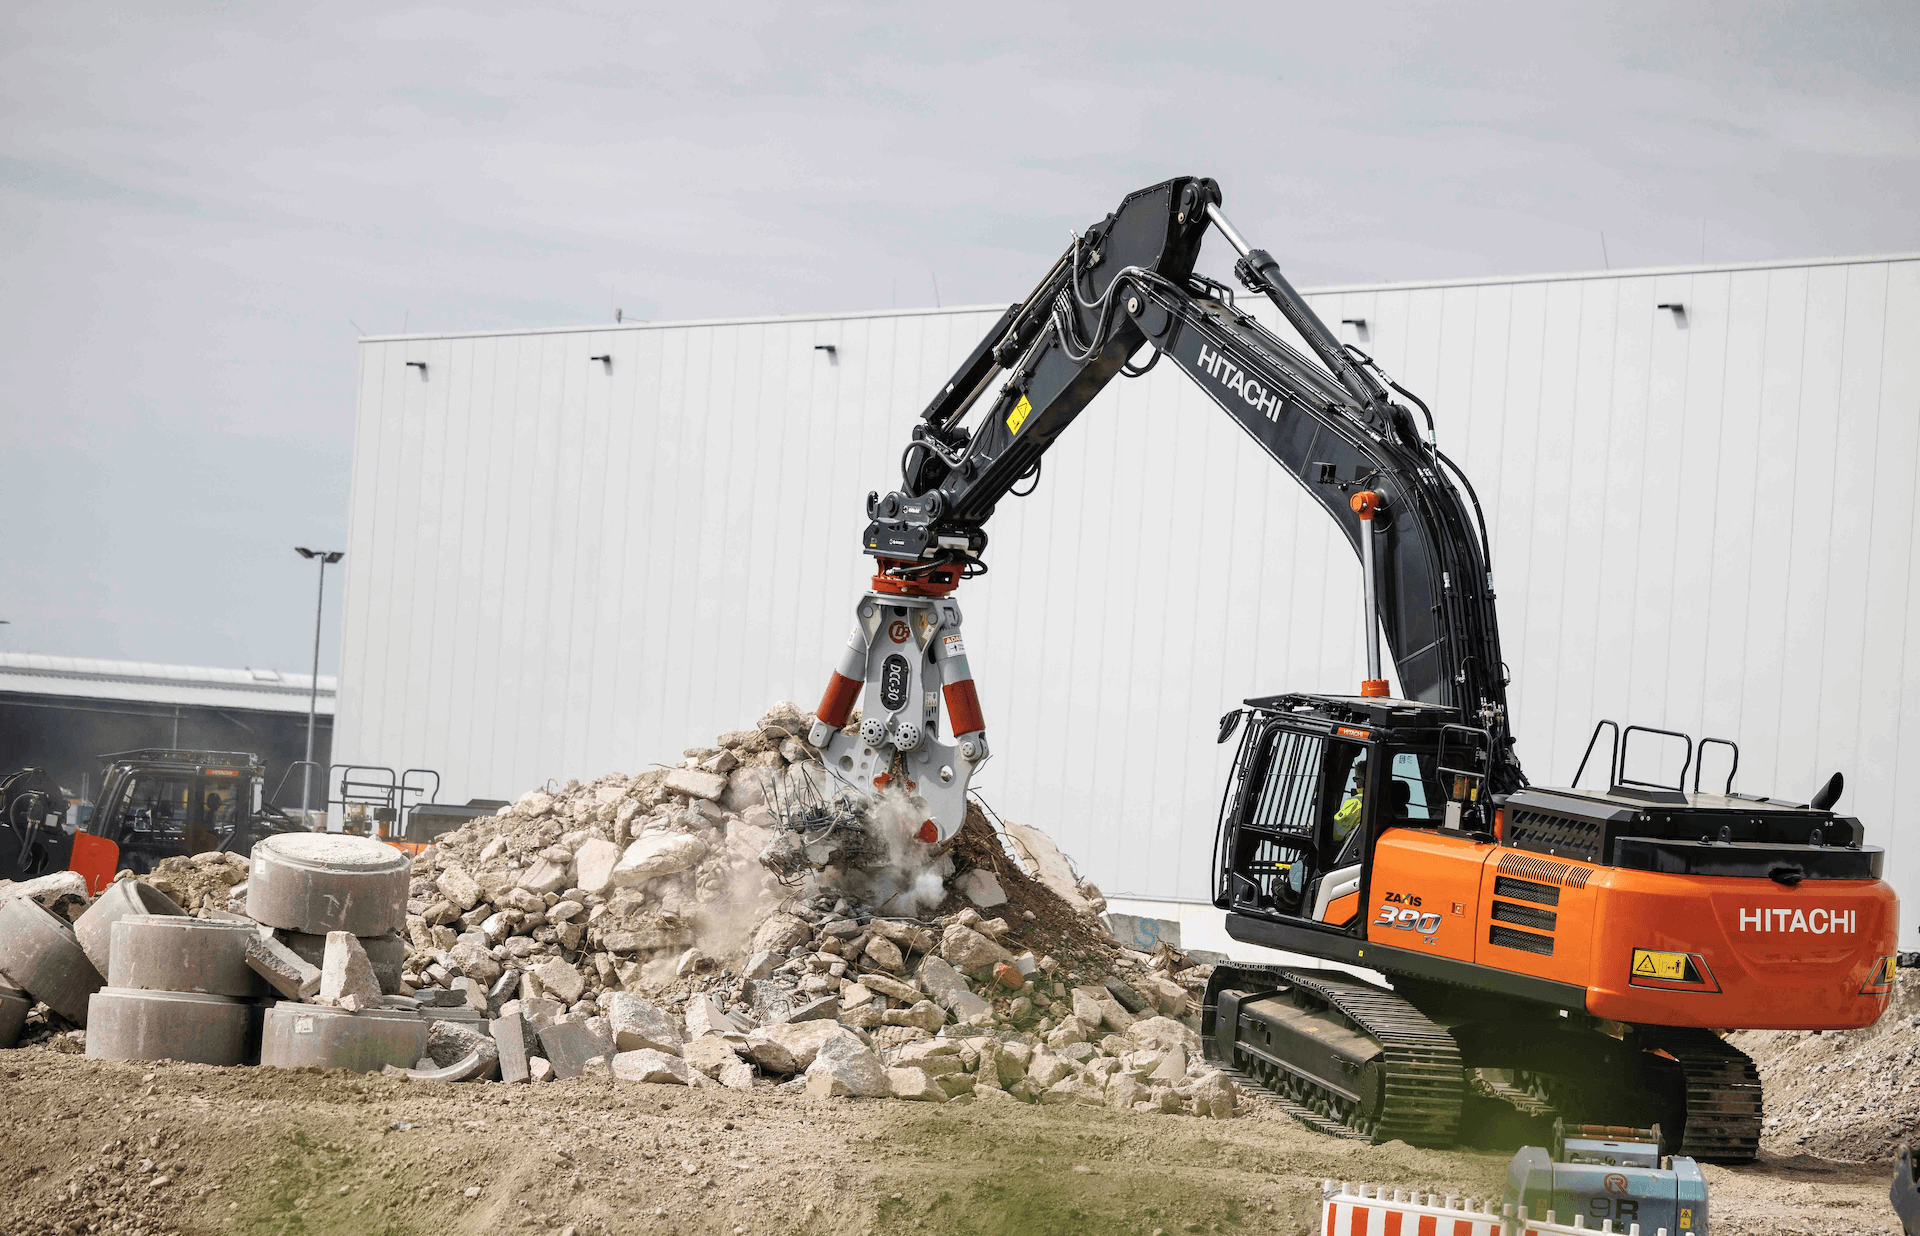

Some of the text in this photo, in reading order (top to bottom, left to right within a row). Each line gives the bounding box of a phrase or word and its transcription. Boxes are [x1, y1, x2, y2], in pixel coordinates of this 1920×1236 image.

[1197, 343, 1283, 423] HITACHI
[888, 664, 902, 701] DCC-30
[1343, 729, 1364, 738] HITACHI
[1384, 891, 1422, 907] ZAXIS
[1372, 904, 1442, 935] 390
[1739, 908, 1856, 934] HITACHI
[1423, 935, 1439, 946] TC
[1590, 1197, 1639, 1220] 9R
